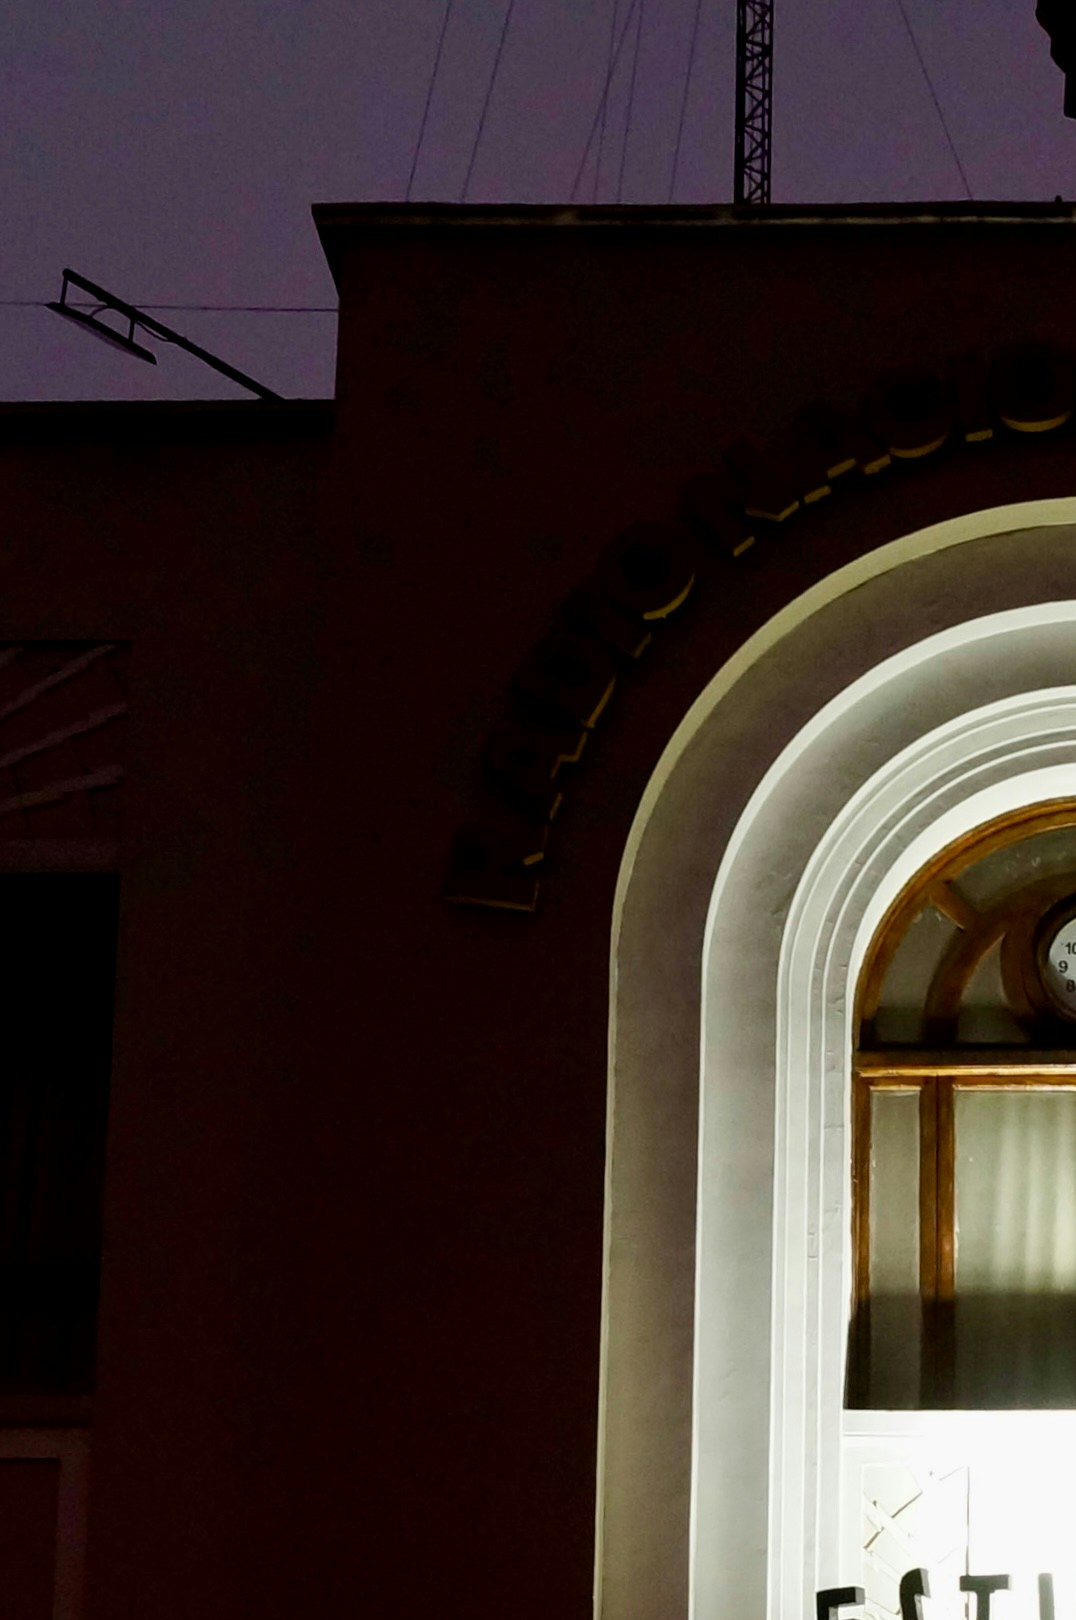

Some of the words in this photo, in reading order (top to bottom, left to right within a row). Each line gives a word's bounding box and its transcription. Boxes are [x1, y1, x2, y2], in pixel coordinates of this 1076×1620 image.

[440, 522, 702, 914] RADIO
[1058, 960, 1068, 973] 9
[1066, 979, 1076, 992] 8
